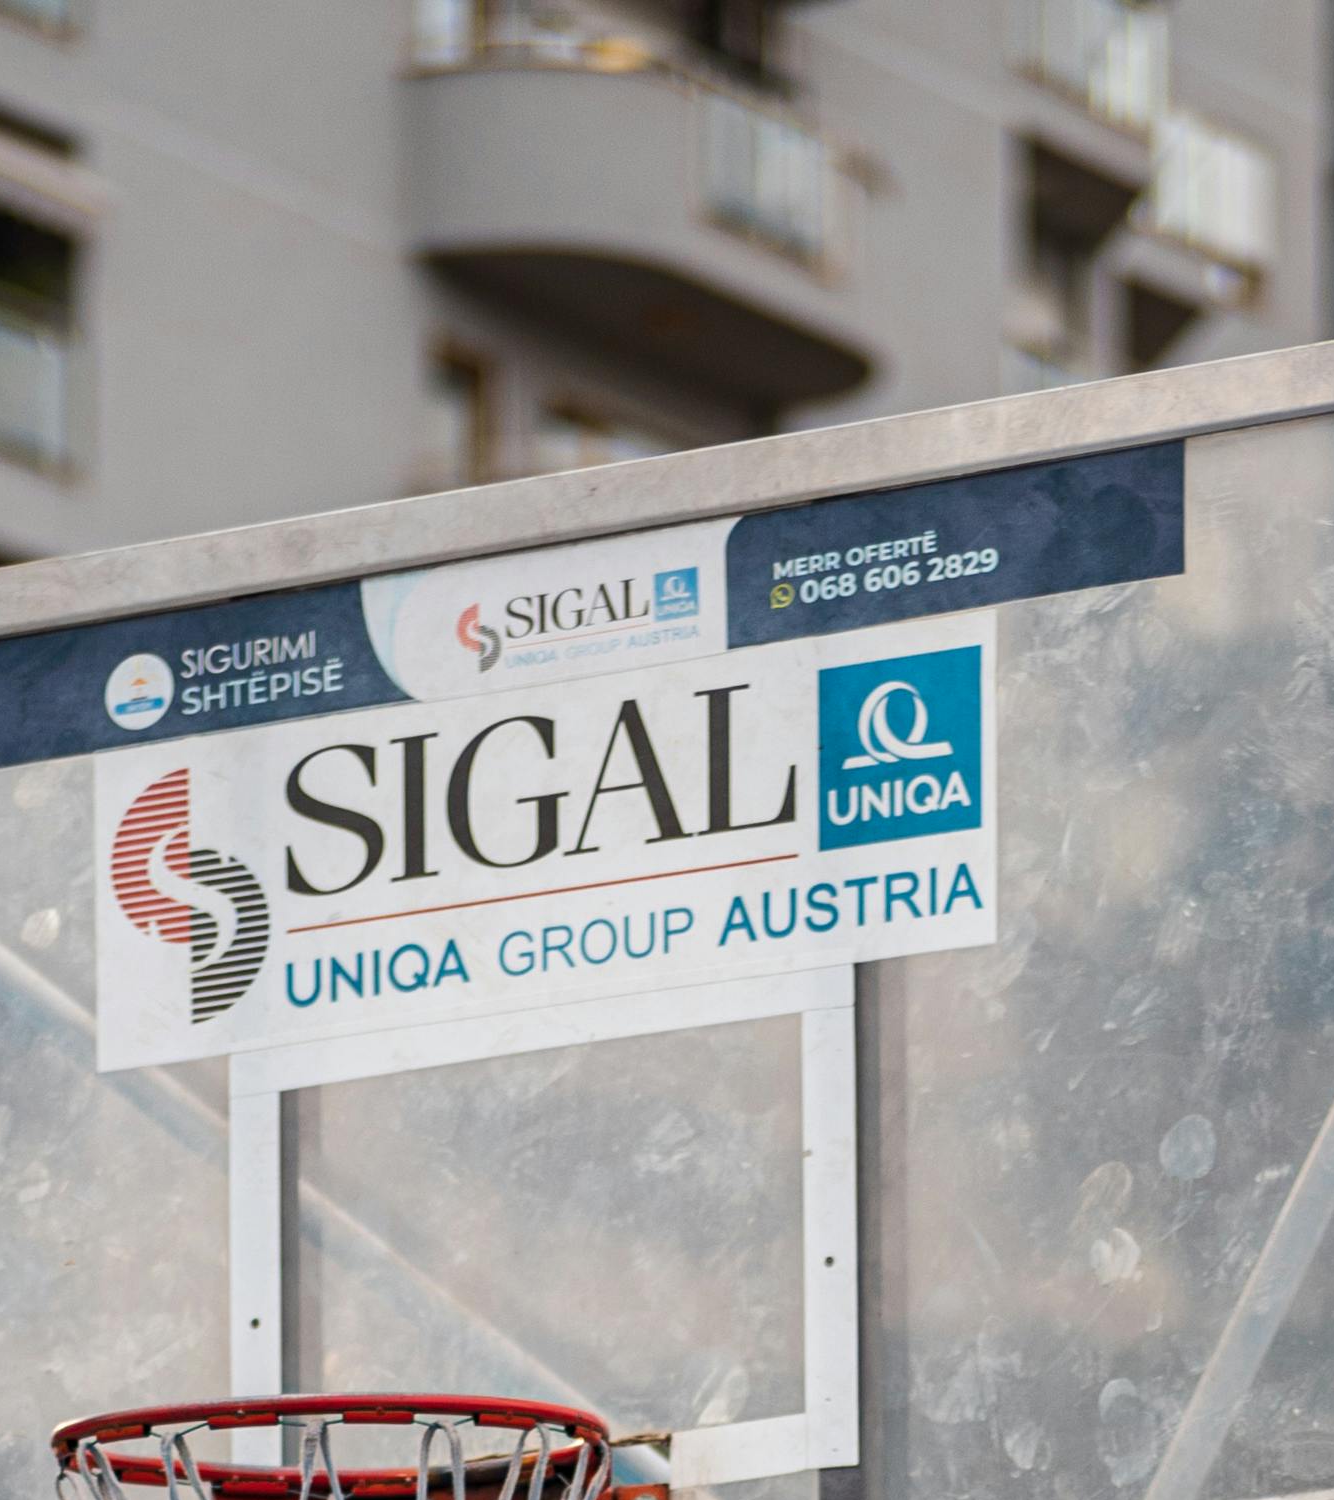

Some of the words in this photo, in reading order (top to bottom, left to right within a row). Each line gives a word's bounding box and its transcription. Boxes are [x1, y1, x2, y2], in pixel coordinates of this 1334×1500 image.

[773, 552, 841, 580] MERR
[845, 530, 937, 566] OFERTË
[799, 573, 857, 603] 068
[863, 561, 921, 592] 606
[927, 548, 999, 582] 2829
[505, 578, 649, 639] SIGAL
[181, 630, 317, 679] SIGURIMI
[627, 625, 700, 648] AUSTRIA
[181, 658, 345, 715] SHTËPISË
[285, 684, 798, 896] SIGAL
[827, 771, 972, 826] UNIQA
[285, 938, 471, 1008] UNIQA
[499, 907, 695, 976] GROUP
[719, 862, 984, 947] AUSTRIA
